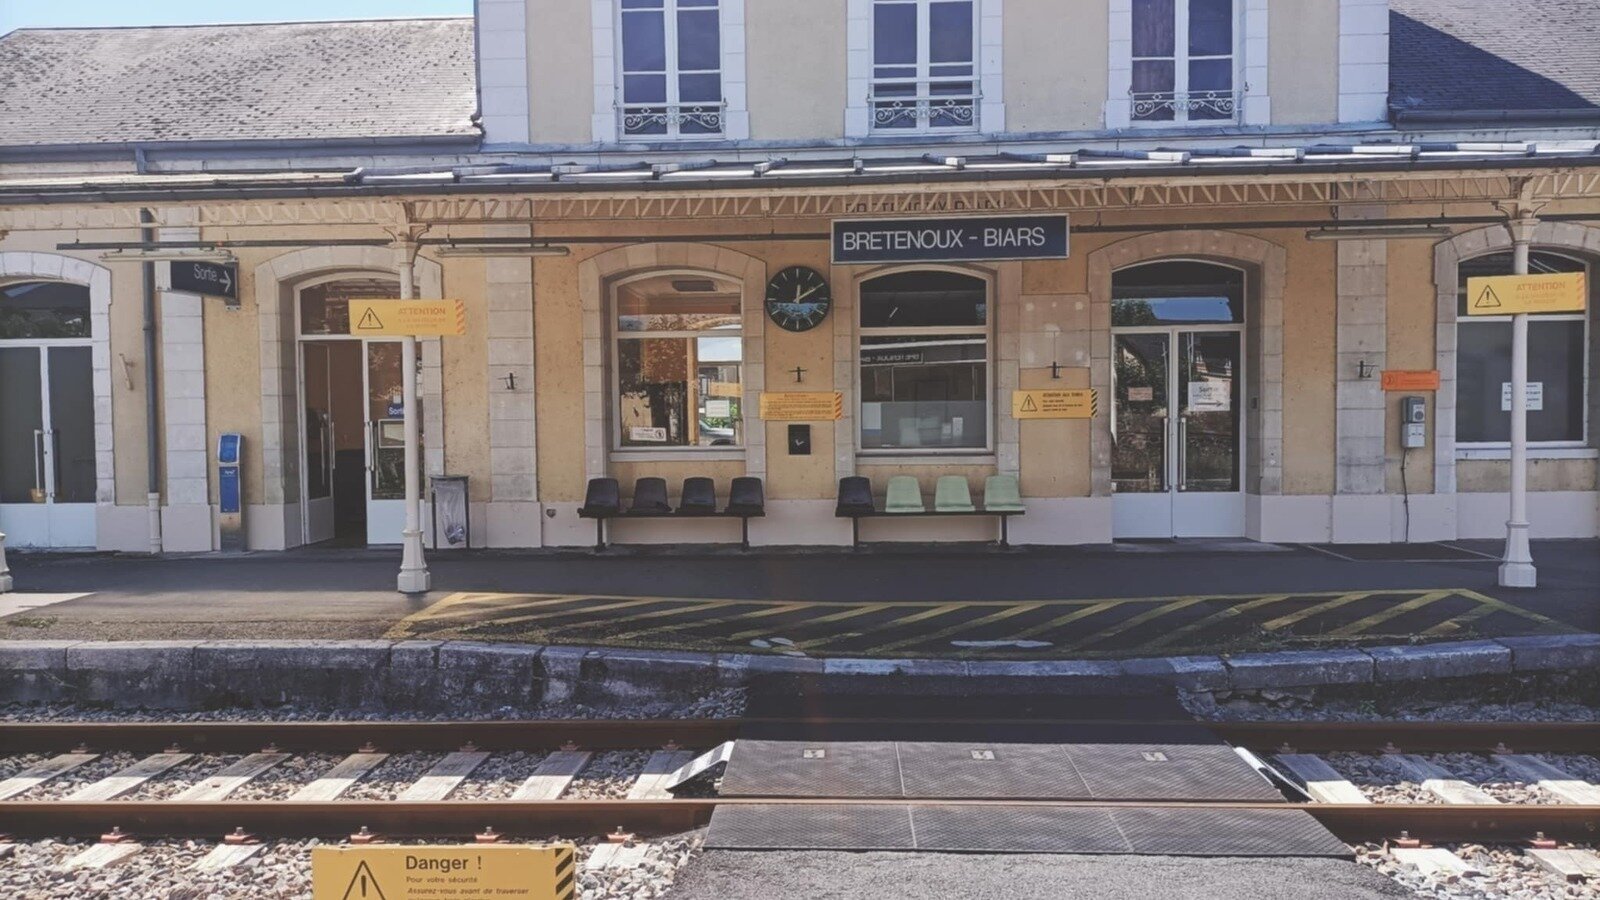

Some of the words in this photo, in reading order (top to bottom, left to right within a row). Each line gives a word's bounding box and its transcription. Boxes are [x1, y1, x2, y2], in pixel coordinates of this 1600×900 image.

[842, 229, 963, 250] BRETENOUX
[984, 226, 1046, 247] BIARS
[193, 263, 217, 281] Sortie
[1516, 281, 1566, 291] ATTENTION
[398, 307, 446, 316] ATTENTION
[405, 856, 469, 873] Danger
